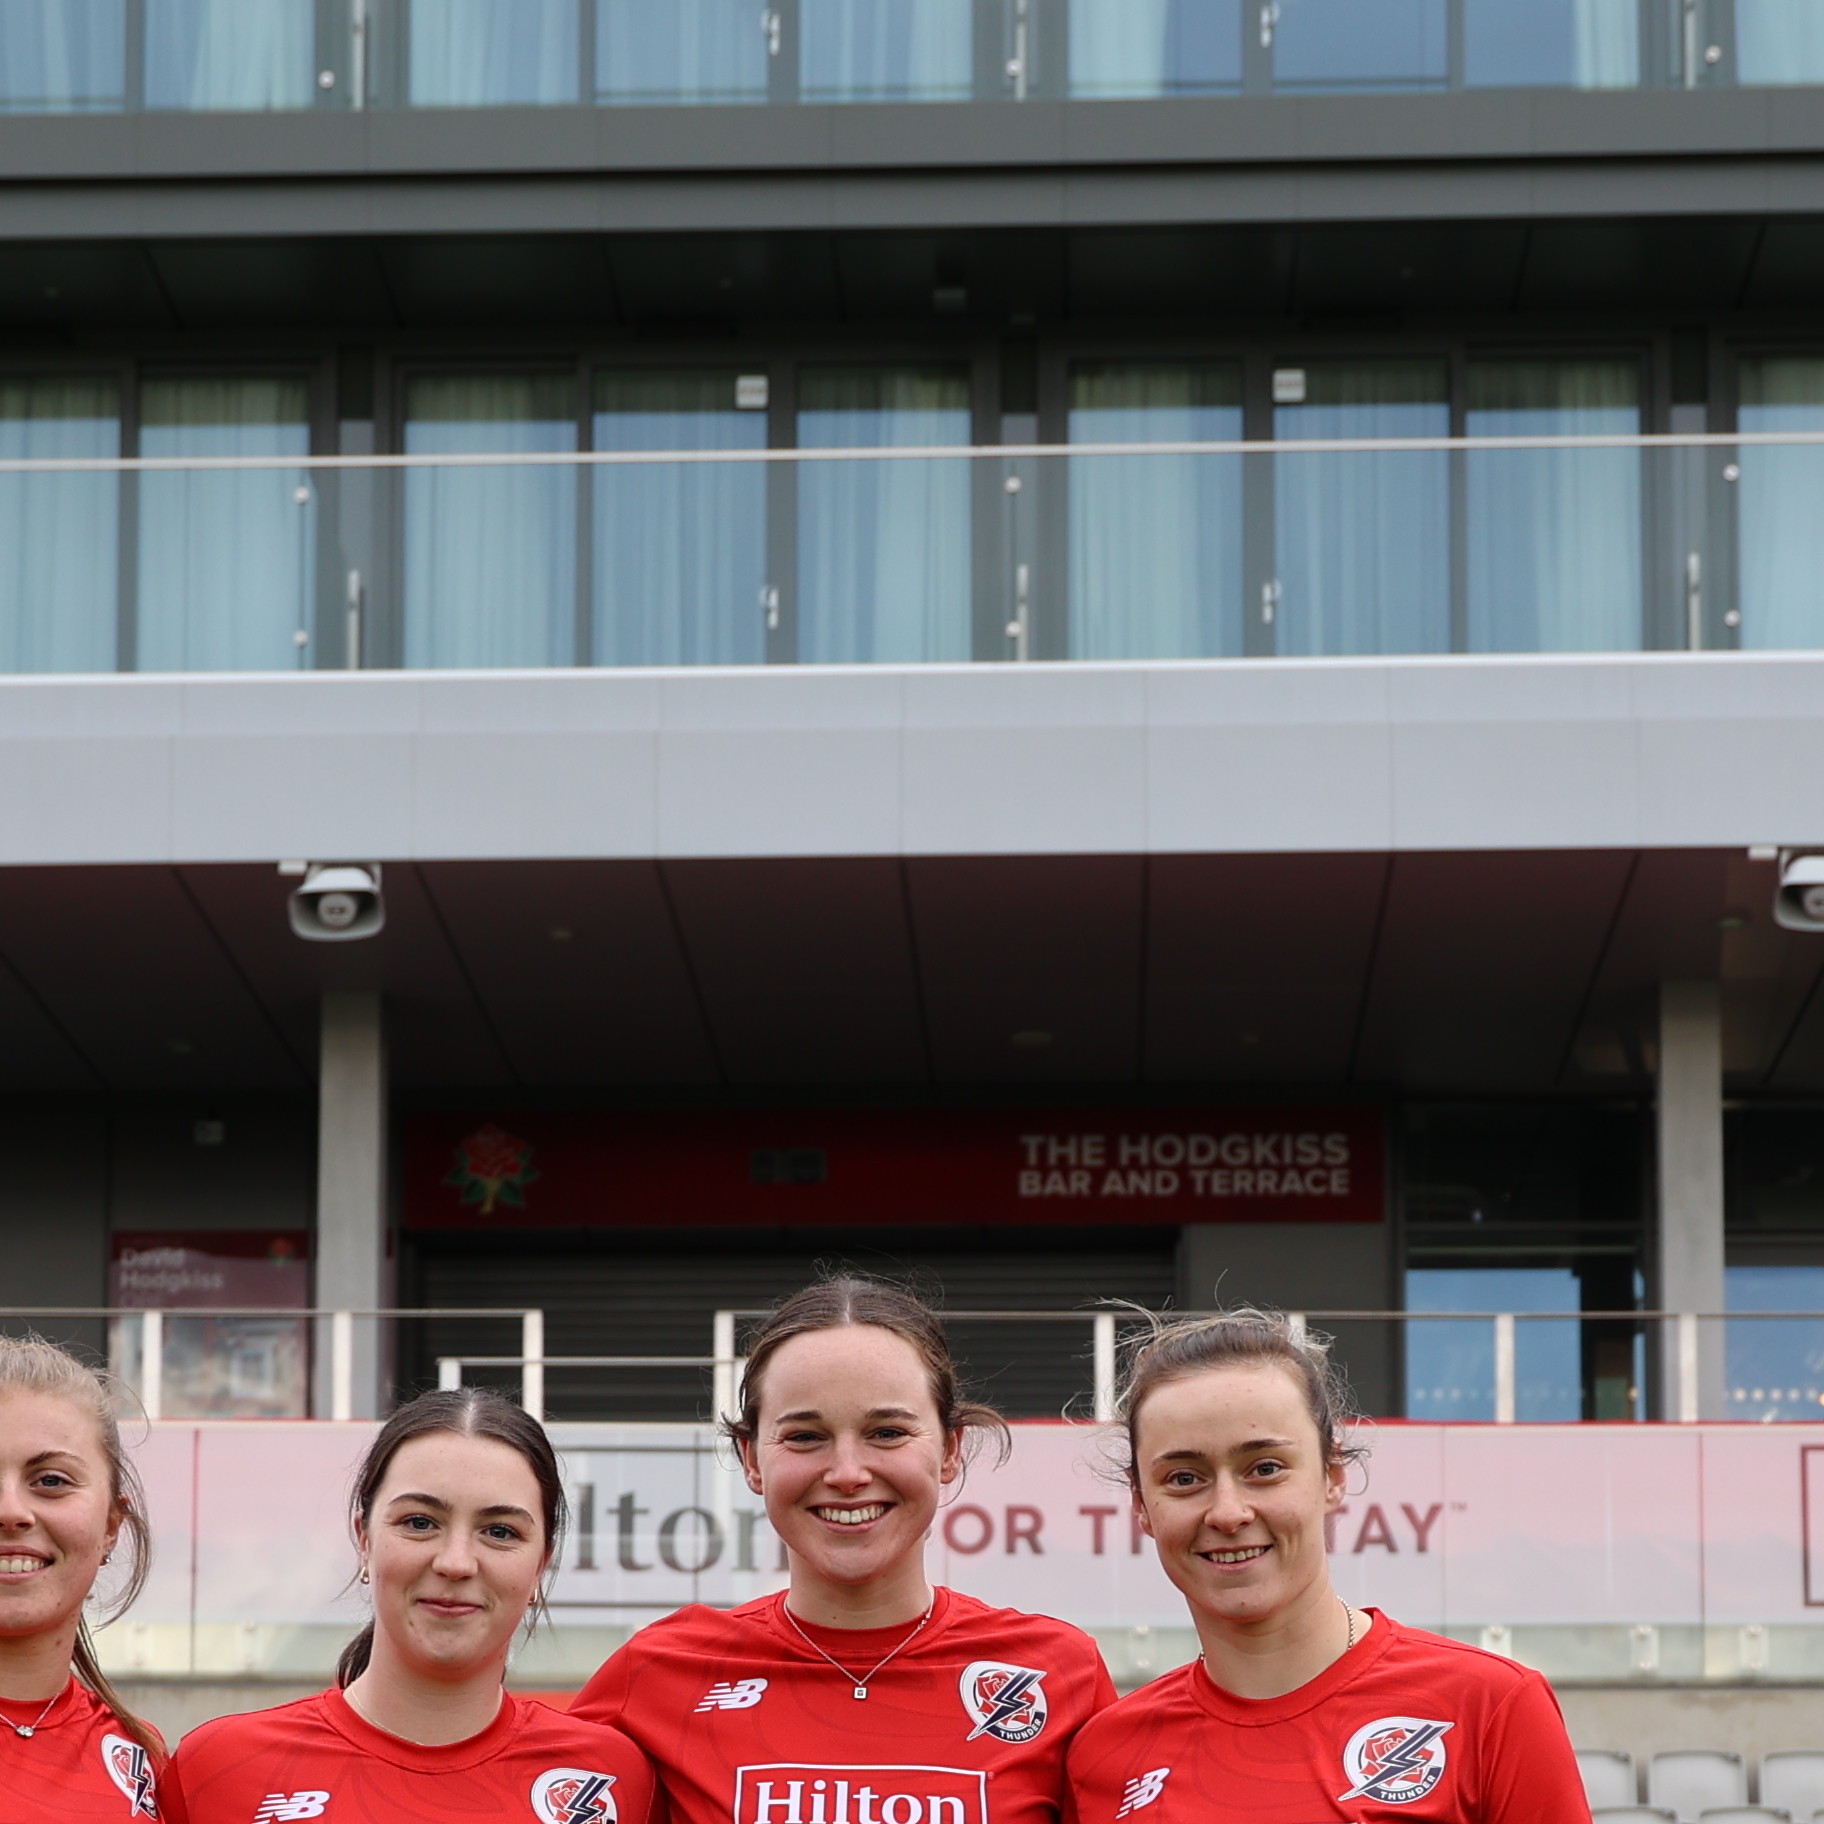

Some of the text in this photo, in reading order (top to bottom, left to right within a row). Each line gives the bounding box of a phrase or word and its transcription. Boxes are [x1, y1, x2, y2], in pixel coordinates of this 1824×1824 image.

[1020, 1133, 1350, 1167] THE HODGKISS
[1019, 1168, 1351, 1196] BAR AND TERRACE
[572, 1482, 790, 1573] lton
[943, 1504, 1045, 1555] OR
[1324, 1503, 1444, 1554] TAY
[999, 1718, 1042, 1741] THUNDER
[1380, 1774, 1436, 1801] THUNDER
